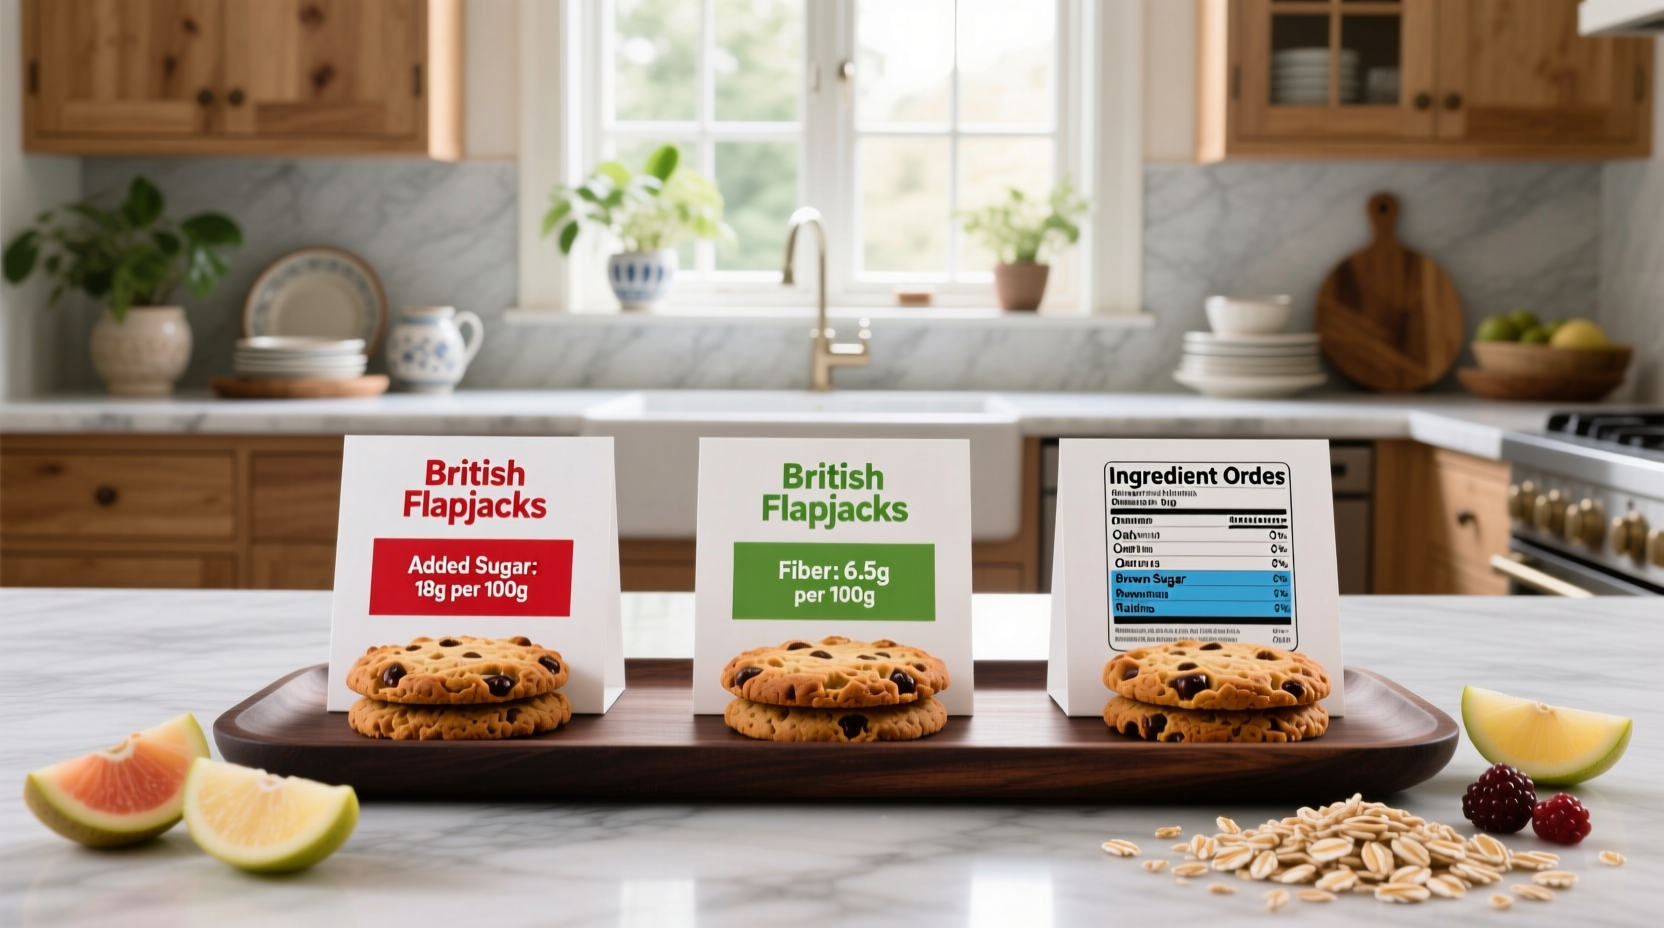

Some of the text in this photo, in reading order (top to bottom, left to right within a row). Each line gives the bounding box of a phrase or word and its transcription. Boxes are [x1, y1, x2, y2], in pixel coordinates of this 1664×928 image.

[425, 459, 525, 486] British
[783, 462, 884, 491] British
[1109, 466, 1286, 489] Ingredient Ordes
[403, 489, 547, 526] Flapjacks
[762, 493, 909, 530] Flapjacks
[407, 555, 538, 579] Added Sugar:
[778, 560, 890, 586] Fiber: 6.5g
[415, 580, 529, 602] 18g per 100g
[794, 586, 875, 608] per 100g
